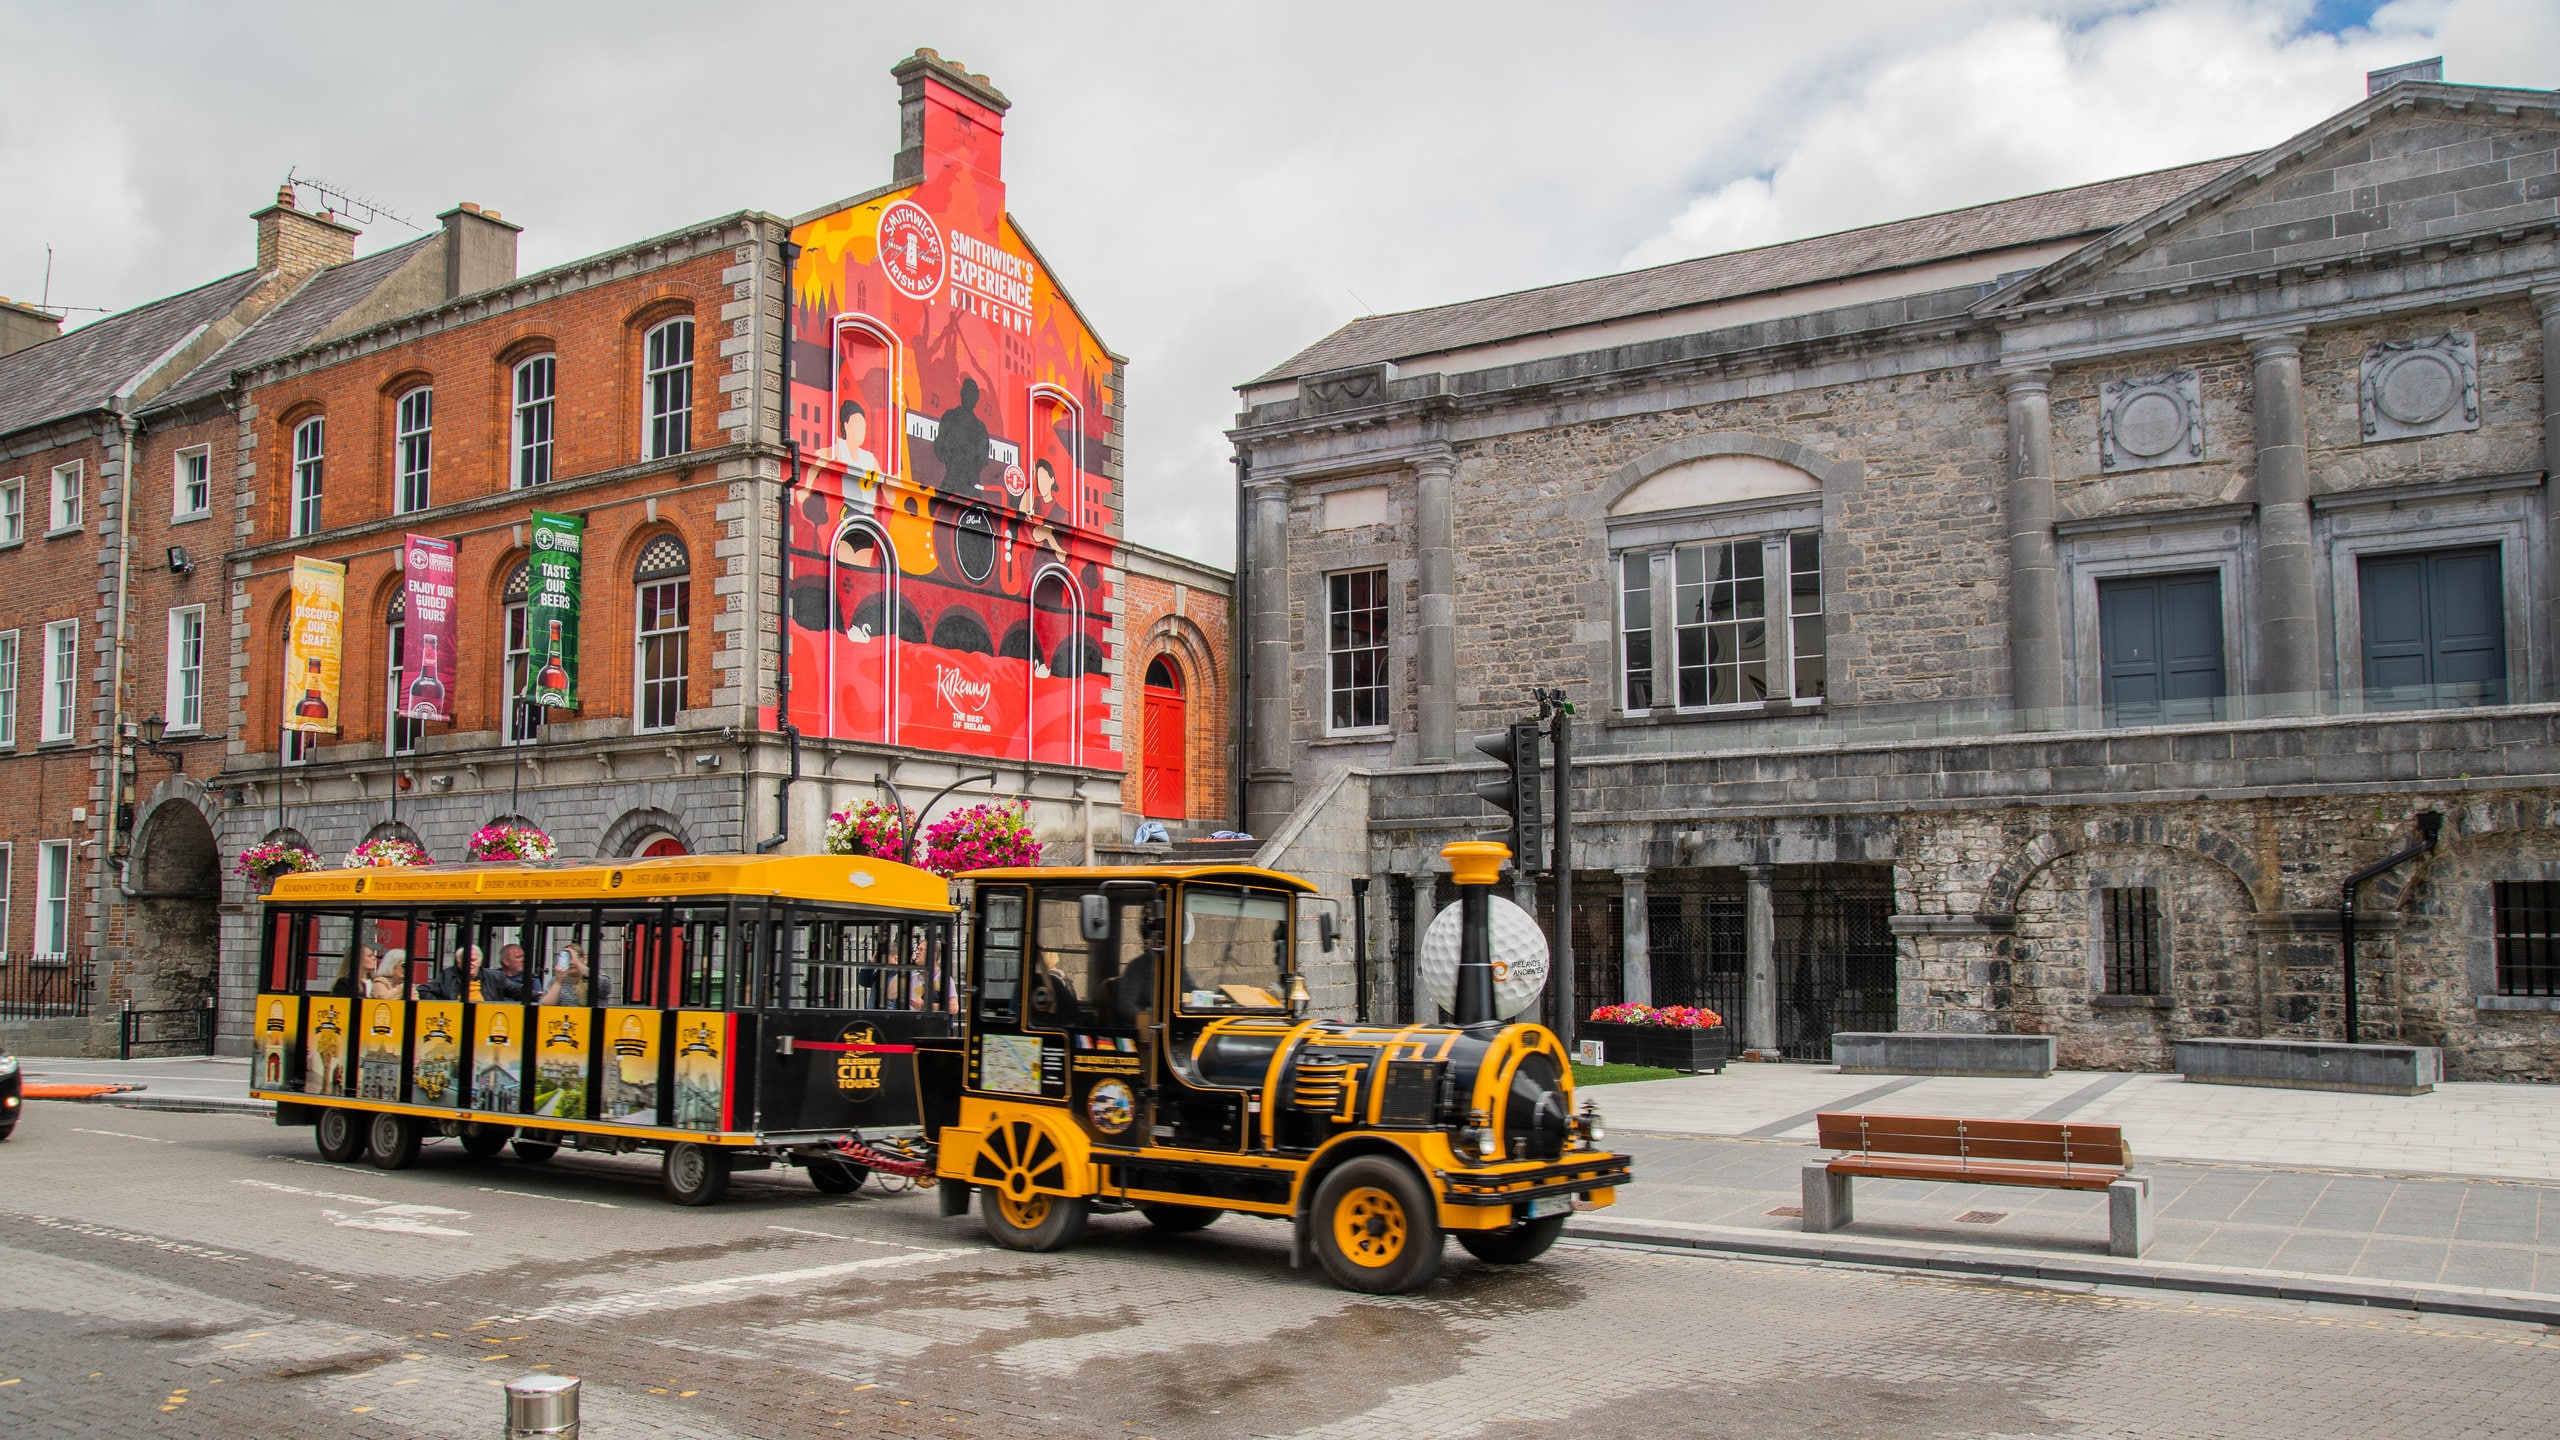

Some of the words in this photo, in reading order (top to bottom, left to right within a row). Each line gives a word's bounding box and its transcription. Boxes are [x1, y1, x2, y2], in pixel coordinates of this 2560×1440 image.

[951, 229, 1034, 284] SMITHWICK'S
[887, 258, 915, 291] IRISH
[917, 273, 935, 292] ALE
[951, 254, 1033, 310] EXPERIENCE
[951, 287, 1033, 337] KILKENNY
[541, 562, 571, 580] TASTE
[408, 579, 436, 595] ENJOY
[437, 584, 454, 598] OUR
[546, 578, 566, 594] OUR
[415, 594, 447, 610] GUIDED
[540, 592, 571, 609] BEERS
[295, 605, 340, 623] DISCOVER
[417, 607, 446, 622] TOURS
[307, 620, 327, 634] OUR
[301, 632, 331, 647] CRAFT
[936, 663, 991, 713] Kilkenny
[953, 712, 966, 722] THE
[967, 714, 984, 723] BEST
[953, 721, 962, 729] OF
[963, 723, 992, 733] IRELAND
[1598, 1046, 1602, 1060] 1
[837, 1065, 882, 1079] CITY
[837, 1078, 881, 1089] TOURS
